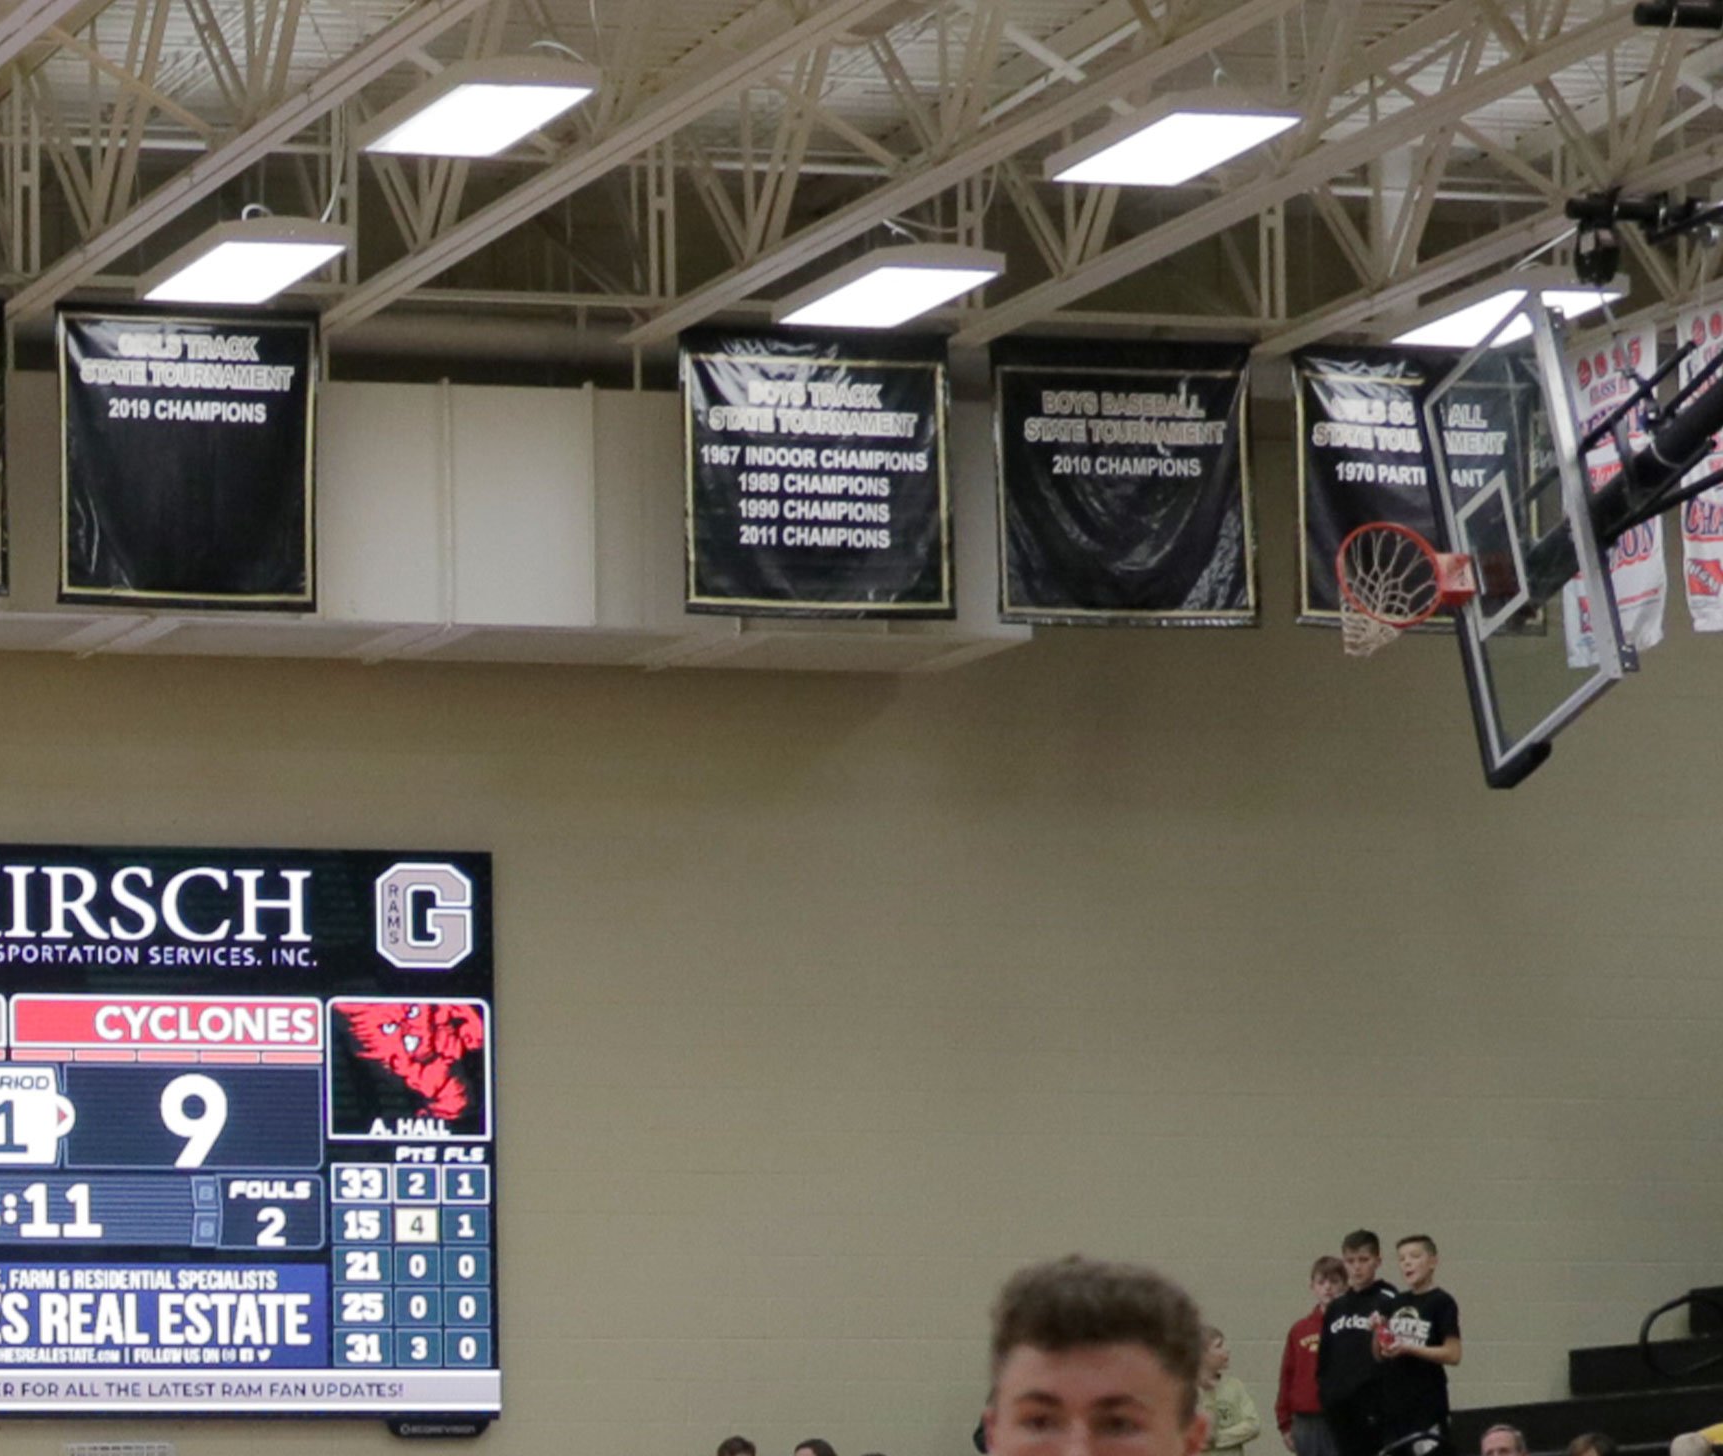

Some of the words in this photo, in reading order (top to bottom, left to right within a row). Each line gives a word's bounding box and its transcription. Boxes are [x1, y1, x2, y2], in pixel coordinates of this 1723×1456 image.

[108, 399, 151, 420] 2019
[155, 401, 267, 424] CHAMPIONS
[1043, 391, 1098, 414] BOYS
[1101, 393, 1205, 418] BASEBALL
[1024, 419, 1088, 442] STATE
[1091, 420, 1225, 445] TOURNAMENT
[701, 444, 742, 465] 1967
[745, 446, 817, 468] INDOOR
[821, 449, 928, 472] CHAMPIONS
[1053, 455, 1090, 474] 2010
[1095, 456, 1201, 476] CHAMPIONS
[738, 473, 779, 492] 1989
[783, 474, 890, 496] CHAMPIONS
[739, 500, 780, 519] 1990
[783, 501, 890, 522] CHAMPIONS
[739, 525, 779, 545] 2011
[783, 526, 890, 549] CHAMPIONS
[376, 863, 471, 968] G
[388, 885, 399, 944] RAMS
[273, 948, 318, 967] INC.
[95, 1006, 315, 1041] CYCLONES
[161, 1073, 227, 1168] 9
[370, 1117, 392, 1136] A.
[397, 1119, 450, 1136] HALL
[395, 1147, 436, 1163] PTS
[443, 1148, 484, 1163] FLS
[229, 1181, 310, 1199] FOULS
[341, 1169, 383, 1197] 33
[256, 1208, 285, 1245] 2
[344, 1210, 380, 1238] 15
[346, 1252, 380, 1280] 21
[10, 1270, 54, 1290] FARM
[59, 1270, 69, 1290] &
[73, 1270, 174, 1290] RESIDENTIAL
[178, 1270, 277, 1290] SPECIALISTS
[40, 1293, 149, 1346] REAL
[158, 1293, 311, 1346] ESTATE
[342, 1293, 384, 1321] 25
[346, 1334, 383, 1362] 31
[22, 1383, 58, 1398] FOR
[65, 1383, 99, 1398] ALL
[105, 1383, 142, 1398] THE
[149, 1383, 215, 1398] LATEST
[222, 1383, 262, 1398] RAM
[269, 1383, 306, 1398] FAN
[312, 1383, 404, 1398] UPDATES!
